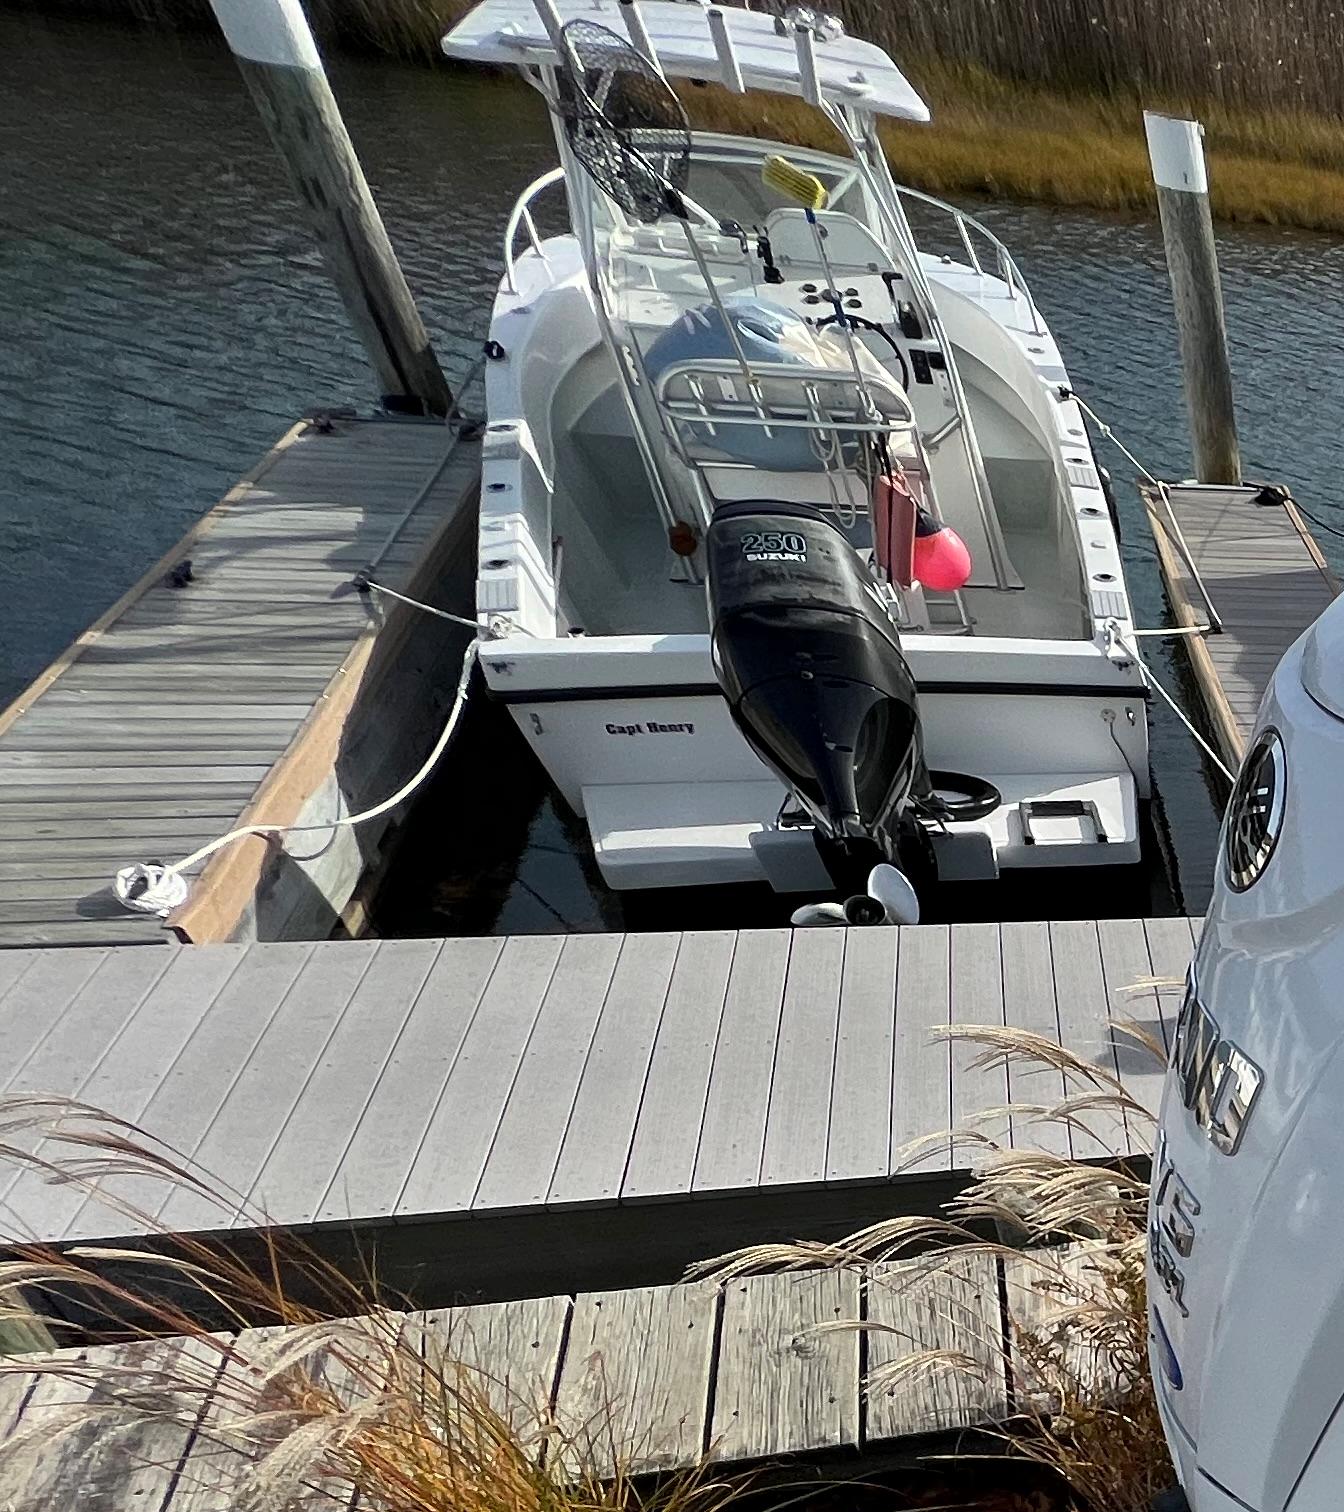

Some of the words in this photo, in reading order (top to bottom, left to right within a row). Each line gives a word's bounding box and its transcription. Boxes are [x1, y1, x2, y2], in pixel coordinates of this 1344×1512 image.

[740, 532, 806, 553] 250
[746, 553, 806, 562] SUZUKI
[605, 724, 643, 736] Capt
[646, 722, 695, 735] Henry
